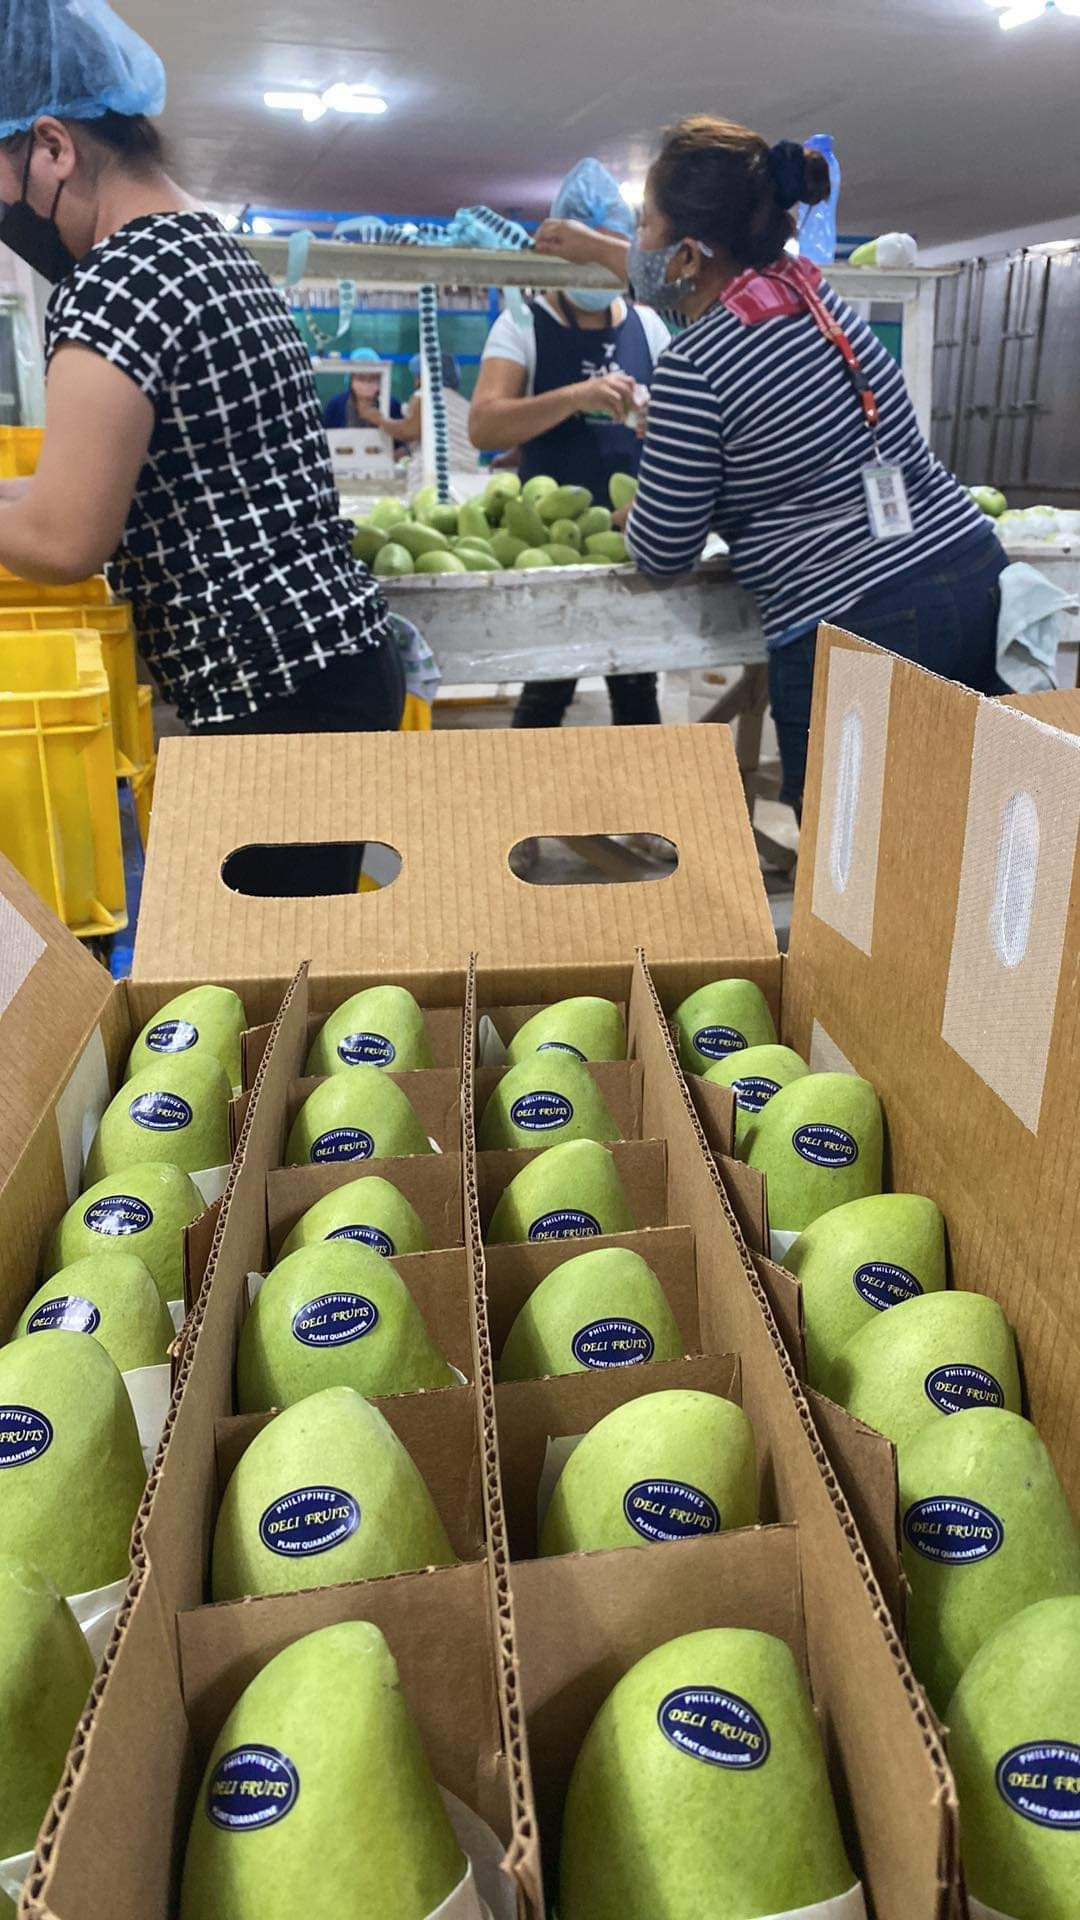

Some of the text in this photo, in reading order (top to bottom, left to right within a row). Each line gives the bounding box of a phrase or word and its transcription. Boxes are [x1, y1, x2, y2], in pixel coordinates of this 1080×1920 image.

[364, 1047, 390, 1056] FRUITS
[719, 1039, 743, 1048] FRUITS
[523, 1096, 559, 1106] PHILIPPINES
[156, 1108, 186, 1119] FRUITS
[539, 1108, 567, 1116] FRUITS
[321, 1133, 358, 1144] PHILIPPINES
[808, 1128, 847, 1141] PHILIPPINES
[316, 1141, 367, 1156] DELI FRUITS
[799, 1136, 853, 1154] DELI FRUITS
[101, 1198, 140, 1210] PHILIPPINES
[543, 1216, 584, 1227] PHILIPPINES
[536, 1228, 594, 1240] DELI FRUITS
[872, 1267, 912, 1287] PHILIPPINES
[860, 1274, 916, 1299] DELI FRUIT
[862, 1288, 878, 1302] PLANT
[307, 1296, 356, 1313] PHILIPPINES
[33, 1317, 52, 1327] DELI
[300, 1307, 369, 1330] DELI FRUITS
[330, 1321, 367, 1340] QUARANTINE
[588, 1325, 636, 1337] PHILIPPINES
[581, 1339, 647, 1352] DELI FRUITS
[589, 1358, 608, 1368] PLANT
[945, 1370, 991, 1386] PHILIPPINES
[935, 1382, 998, 1403] DELI FRUITS
[940, 1398, 959, 1412] PLANT
[0, 1447, 37, 1463] ARANTINE
[277, 1493, 335, 1514] PHILIPPINES
[648, 1486, 704, 1508] PHILIPPINES
[268, 1506, 350, 1534] DELI FRUITS
[633, 1497, 712, 1528] DELI FRUITS
[921, 1503, 979, 1520] PHILIPPINES
[636, 1517, 658, 1536] PLANT
[912, 1521, 993, 1539] DELI FRUITS
[278, 1524, 346, 1550] PLANT QUARANTINE
[918, 1541, 987, 1558] PLANT QUARANTINE
[684, 1694, 750, 1723] PHILIPPINES
[668, 1709, 761, 1749] DELI FRUITS
[673, 1730, 750, 1762] PLANT QUARANTINE
[224, 1754, 278, 1772] PHILIPPINES
[1019, 1749, 1080, 1764] PHILIPPIN
[215, 1781, 288, 1798] DELI FRUITS
[1009, 1773, 1047, 1790] DELI
[1018, 1797, 1047, 1816] PLANT
